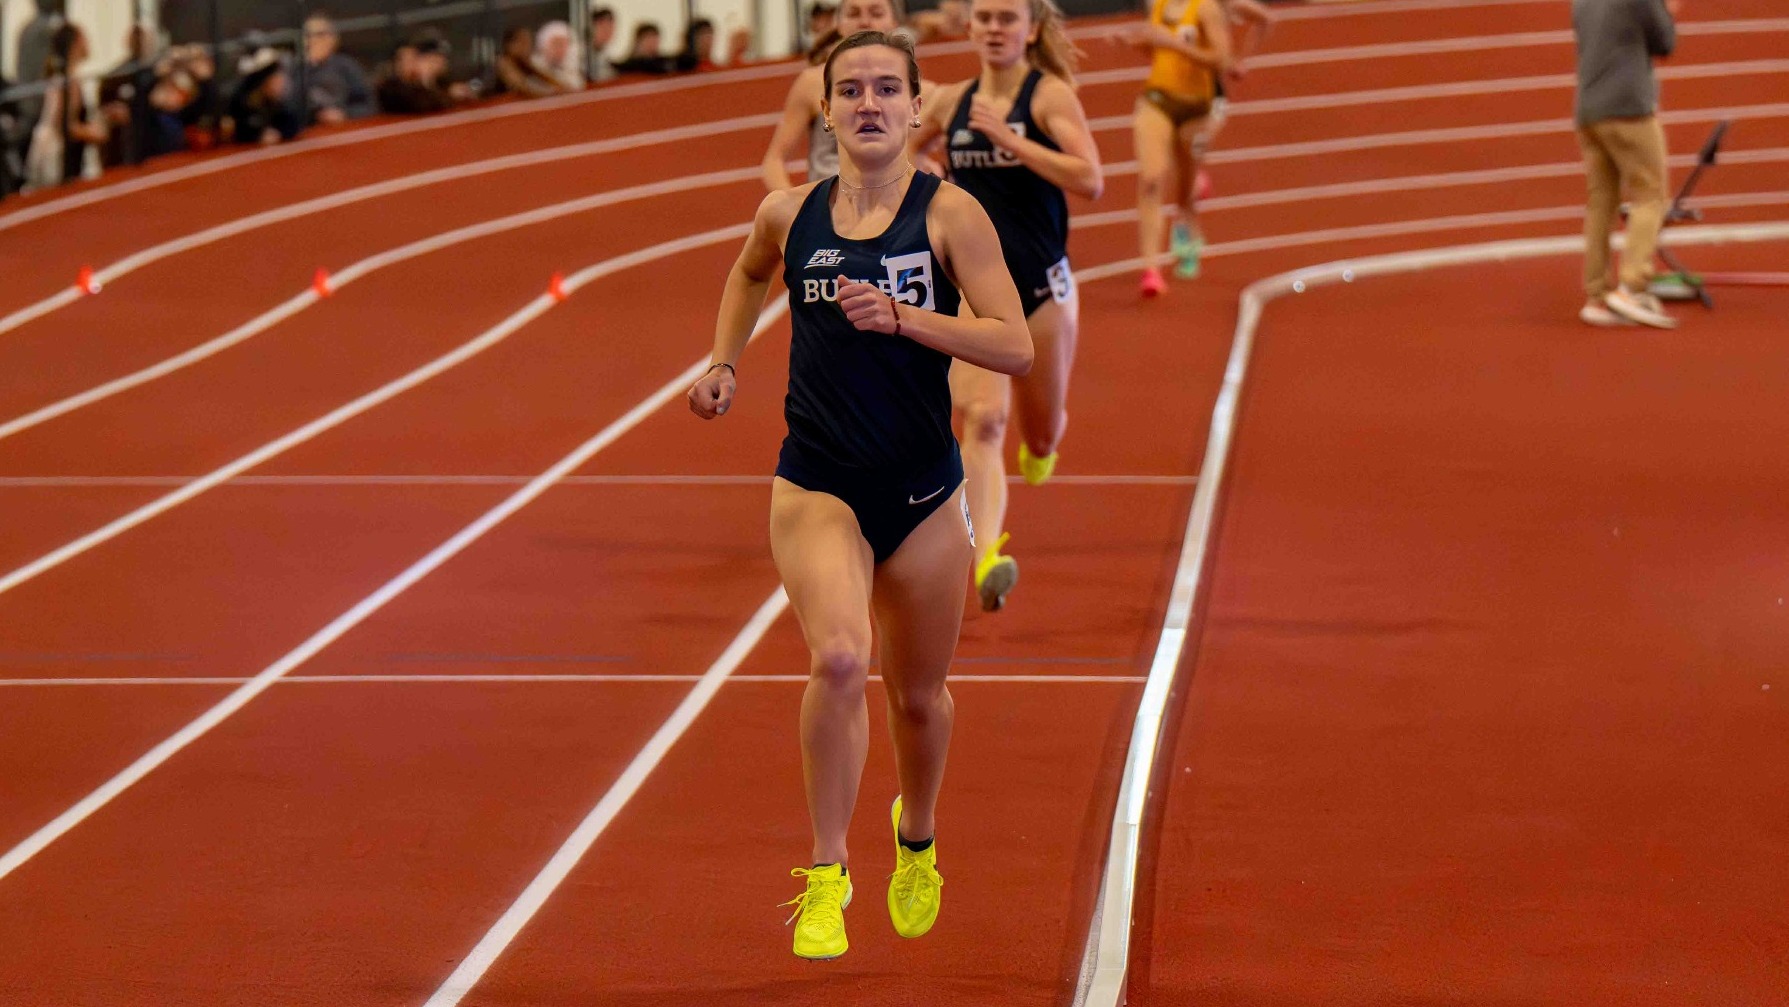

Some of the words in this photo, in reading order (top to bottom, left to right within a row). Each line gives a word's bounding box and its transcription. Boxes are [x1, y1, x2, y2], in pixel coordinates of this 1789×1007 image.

[807, 256, 846, 265] EAST
[813, 249, 841, 257] BIG
[896, 265, 928, 309] 5
[1052, 265, 1069, 298] 3
